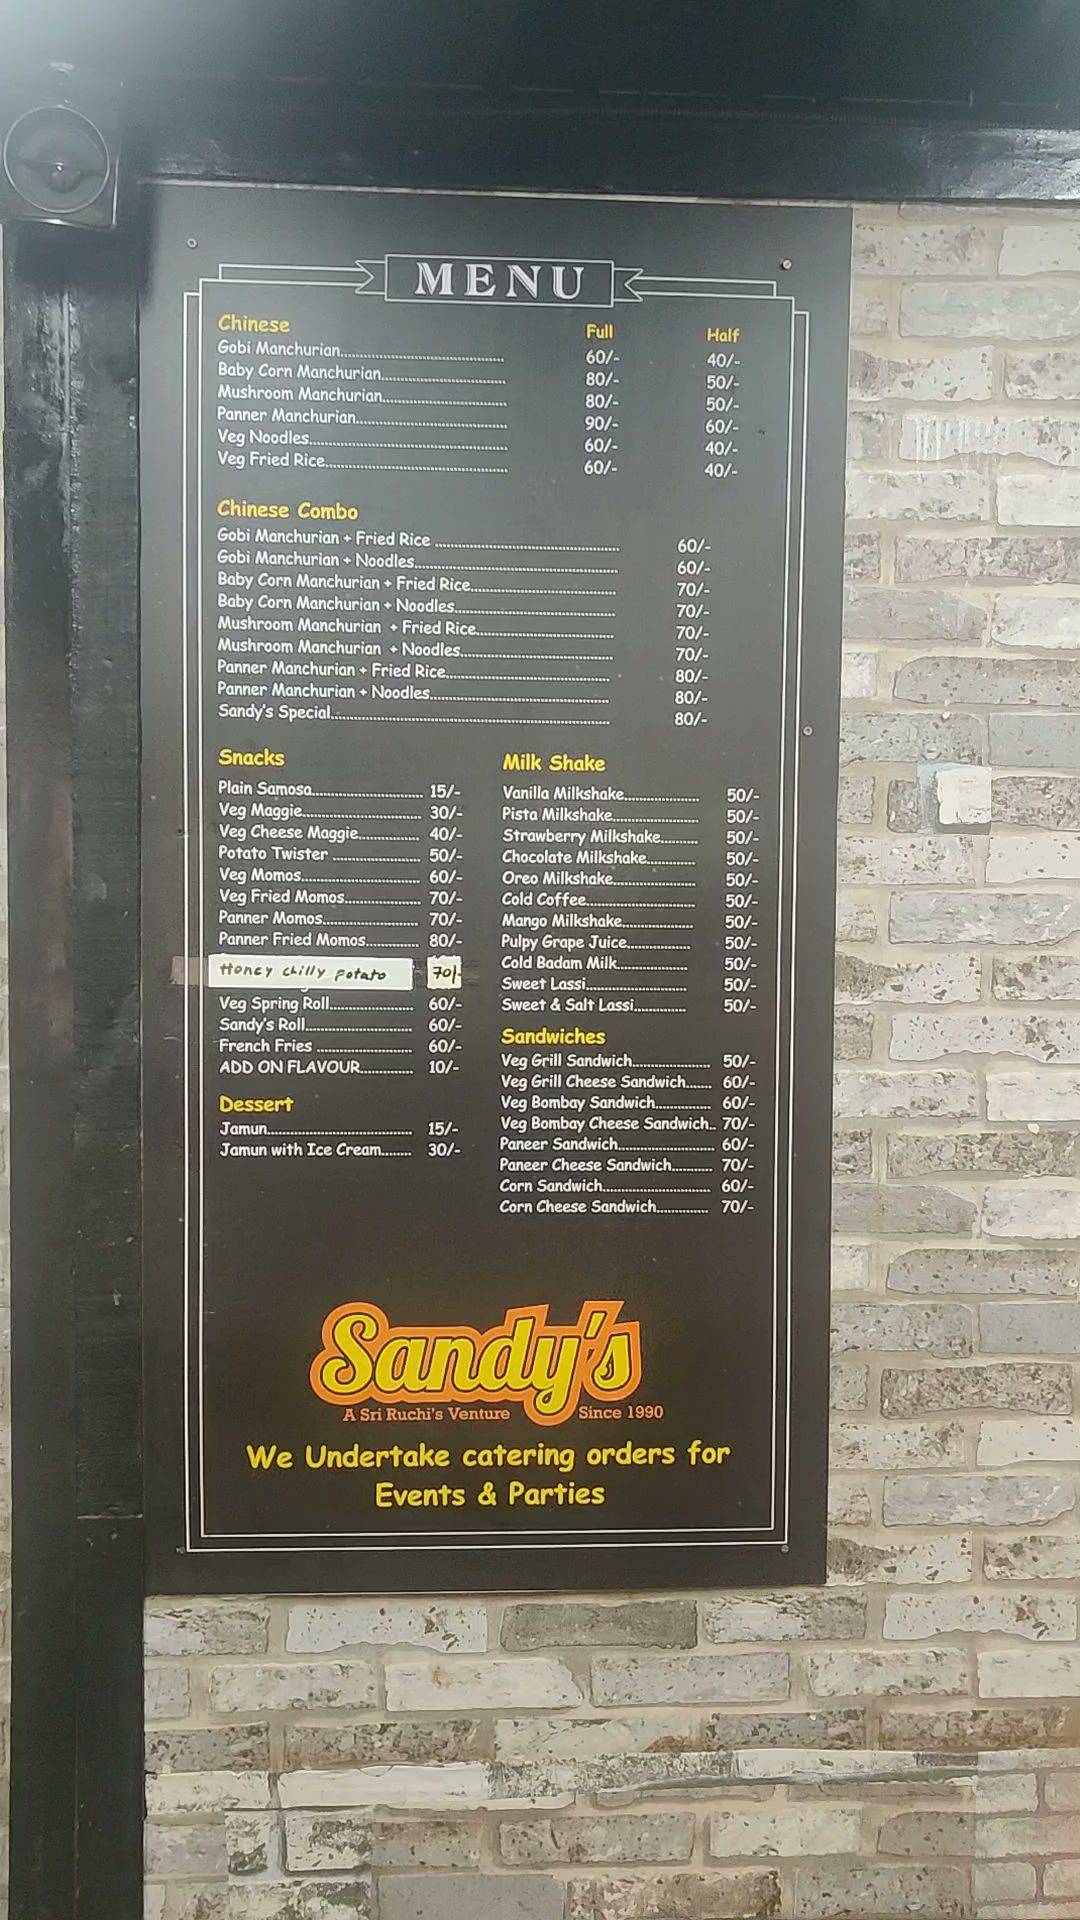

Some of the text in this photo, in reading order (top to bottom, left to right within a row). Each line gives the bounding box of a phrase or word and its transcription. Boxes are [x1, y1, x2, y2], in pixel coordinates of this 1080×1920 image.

[414, 260, 584, 300] MENU
[218, 314, 740, 342] Chinese Full Half
[218, 340, 252, 354] Gobi
[586, 350, 620, 364] 60/-
[707, 354, 740, 367] 40/-
[218, 362, 256, 380] Baby
[260, 364, 292, 377] Corn
[586, 372, 620, 386] 80/-
[706, 375, 740, 389] 50/-
[218, 406, 267, 421] Panner
[584, 416, 618, 430] 90/-
[706, 420, 739, 433] 60/-
[218, 451, 245, 469] Veg
[250, 452, 288, 466] Fried
[584, 460, 618, 474] 60/-
[705, 464, 738, 477] 40/-
[218, 499, 358, 519] Chinese Combo
[218, 528, 250, 541] Gobi
[255, 529, 339, 544] Manchurian
[356, 531, 396, 545] Fried
[678, 539, 711, 552] 60/-
[218, 572, 256, 589] Baby
[260, 573, 292, 586] Corn
[296, 574, 380, 589] Manchurian
[396, 576, 435, 590] Fried
[677, 583, 710, 596] 70/-
[218, 616, 294, 631] Mushroom
[298, 618, 382, 632] Manchurian
[402, 620, 441, 634] Fried
[676, 626, 709, 639] 70/-
[218, 659, 267, 674] Panner
[272, 661, 356, 676] Manchurian
[372, 663, 411, 677] Fried
[675, 669, 708, 682] 80/-
[218, 704, 274, 721] Sandy's
[674, 712, 708, 725] 80/-
[218, 749, 284, 765] Snacks
[503, 754, 606, 771] Milk Shake
[218, 780, 252, 794] Plain
[430, 785, 461, 798] 15/-
[503, 786, 549, 799] Vanilla
[727, 789, 760, 802] 50/-
[219, 803, 246, 820] Veg
[430, 806, 463, 819] 30/-
[502, 829, 586, 846] Strawberry
[727, 831, 759, 844] 50/-
[218, 845, 463, 862] Potato Twister 50/-
[502, 850, 572, 863] Chocolate
[726, 852, 759, 865] 50/-
[220, 889, 246, 906] Veg
[252, 889, 290, 902] Fried
[430, 891, 463, 904] 70/-
[219, 932, 268, 945] Panner
[272, 932, 312, 945] Fried
[430, 934, 462, 947] 80/-
[502, 934, 538, 951] Pulpy
[542, 935, 584, 951] Grape
[725, 937, 758, 949] 50/-
[502, 955, 533, 968] Cold
[537, 956, 582, 969] Badam
[724, 958, 757, 970] 50/-
[220, 997, 246, 1013] Veg
[251, 997, 298, 1013] Spring
[429, 997, 462, 1010] 60/-
[502, 998, 546, 1010] Sweet
[550, 998, 560, 1010] &
[565, 998, 595, 1011] Salt
[724, 999, 756, 1012] 50/-
[501, 1028, 606, 1044] Sandwiches
[219, 1039, 462, 1053] French Fries 60/-
[220, 1060, 253, 1074] ADD
[258, 1060, 283, 1073] ON
[429, 1061, 459, 1073] 10/-
[501, 1075, 528, 1091] Veg
[531, 1074, 562, 1087] Grill
[566, 1075, 616, 1087] Cheese
[723, 1075, 756, 1088] 60/-
[219, 1096, 294, 1112] Dessert
[501, 1117, 527, 1133] Veg
[531, 1116, 585, 1133] Bombay
[589, 1117, 639, 1129] Cheese
[723, 1117, 755, 1130] 70/-
[220, 1143, 267, 1156] Jamun
[271, 1143, 302, 1156] with
[307, 1143, 332, 1156] Ice
[428, 1143, 460, 1156] 30/-
[500, 1158, 548, 1171] Paneer
[552, 1158, 602, 1171] Cheese
[722, 1159, 754, 1171] 70/-
[500, 1200, 532, 1212] Corn
[536, 1200, 587, 1212] Cheese
[722, 1200, 754, 1213] 70/-
[313, 1304, 639, 1423] Sandy's
[343, 1408, 510, 1421] A Sri Ruchi's Venture
[579, 1406, 664, 1419] Since 1990
[246, 1440, 731, 1472] We Undertake catering orders for
[376, 1481, 605, 1507] Events & Parties
